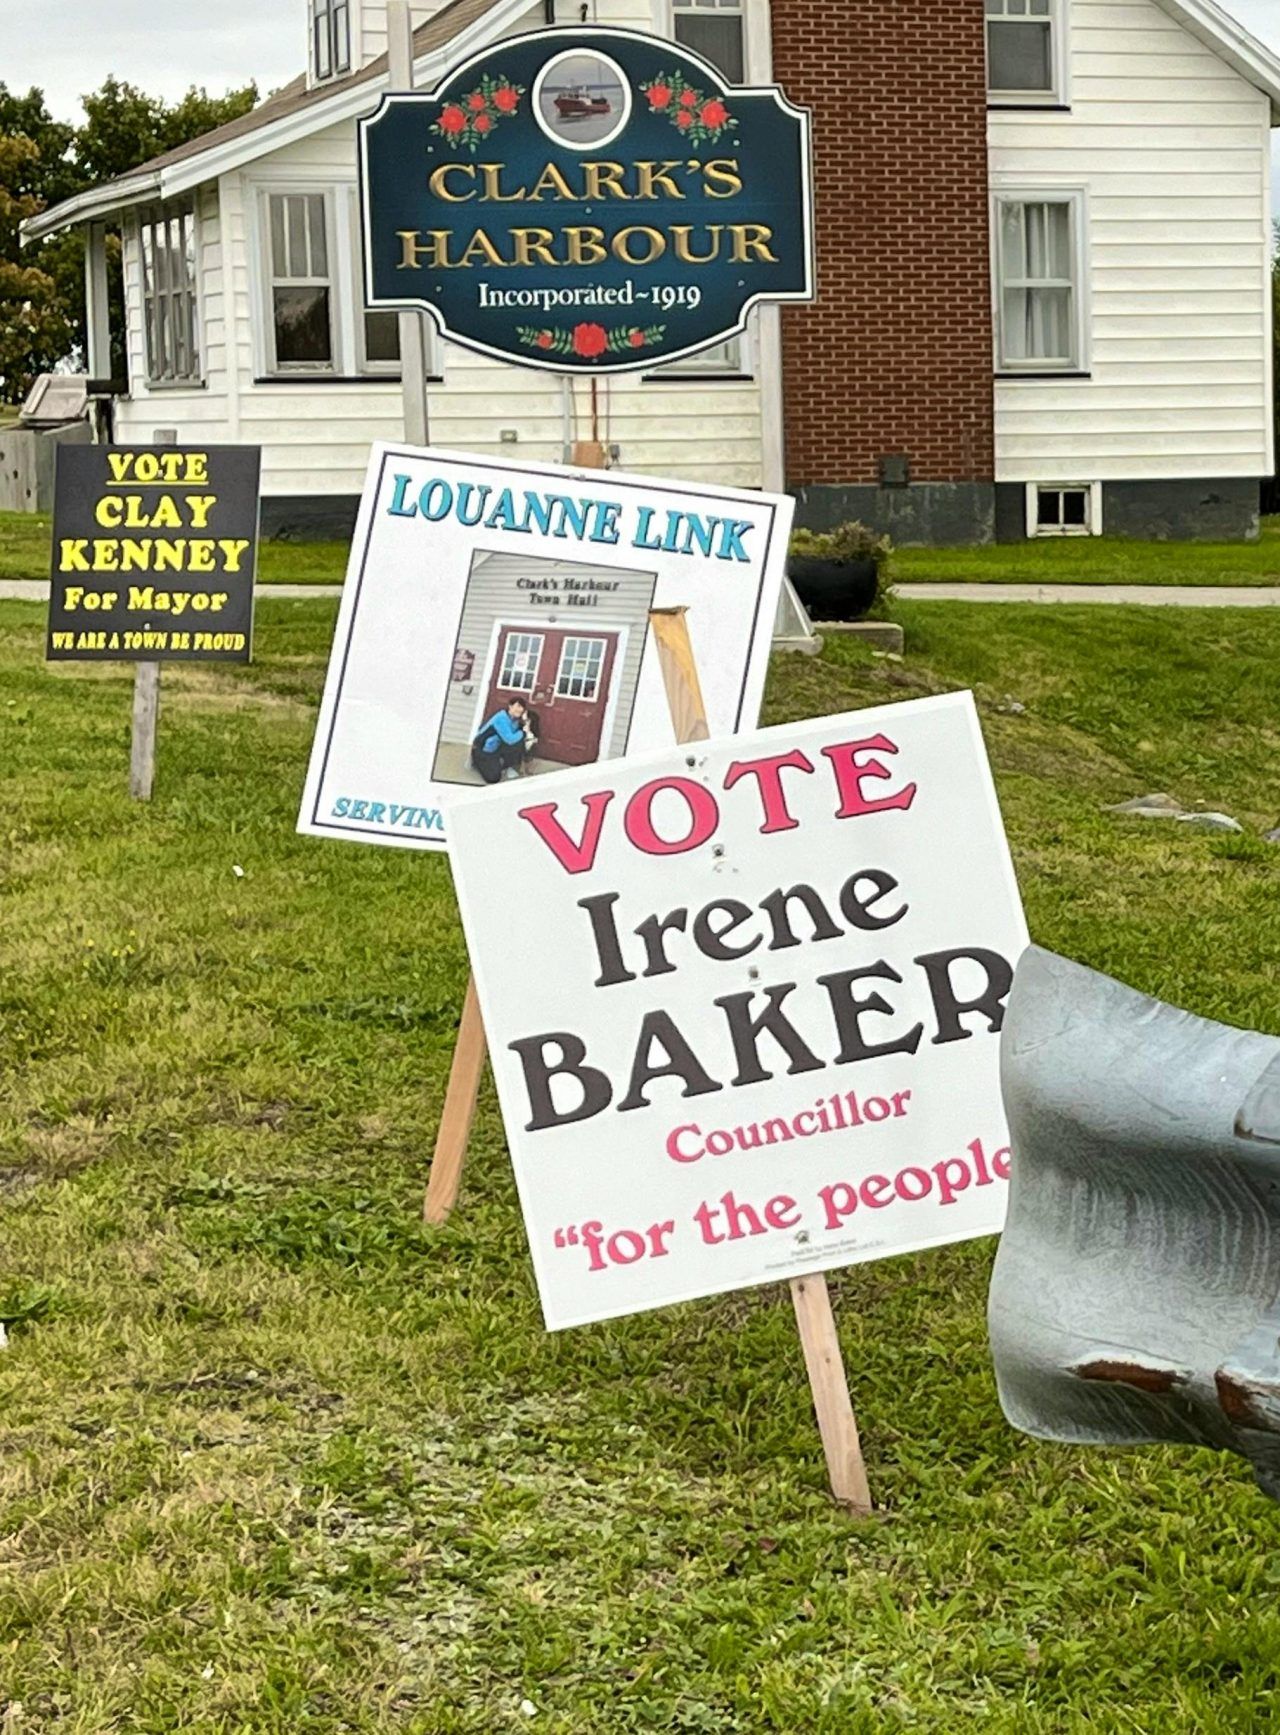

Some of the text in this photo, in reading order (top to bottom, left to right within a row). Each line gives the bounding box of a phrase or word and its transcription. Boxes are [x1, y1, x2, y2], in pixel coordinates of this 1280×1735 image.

[428, 158, 744, 203] CLARK'S
[395, 223, 780, 270] HARBOUR
[107, 453, 208, 482] VOTE
[95, 495, 217, 528] CLAY
[387, 473, 756, 564] LOUANNE LINK
[59, 539, 250, 572] KENNEY
[63, 586, 228, 616] For Mayor
[52, 632, 246, 651] WE ARE A TOWN BE PROUD
[517, 732, 917, 876] VOTE
[577, 868, 910, 988] Irene
[507, 946, 1014, 1133] BAKER
[666, 1088, 912, 1164] Councillor
[692, 1189, 802, 1247] the
